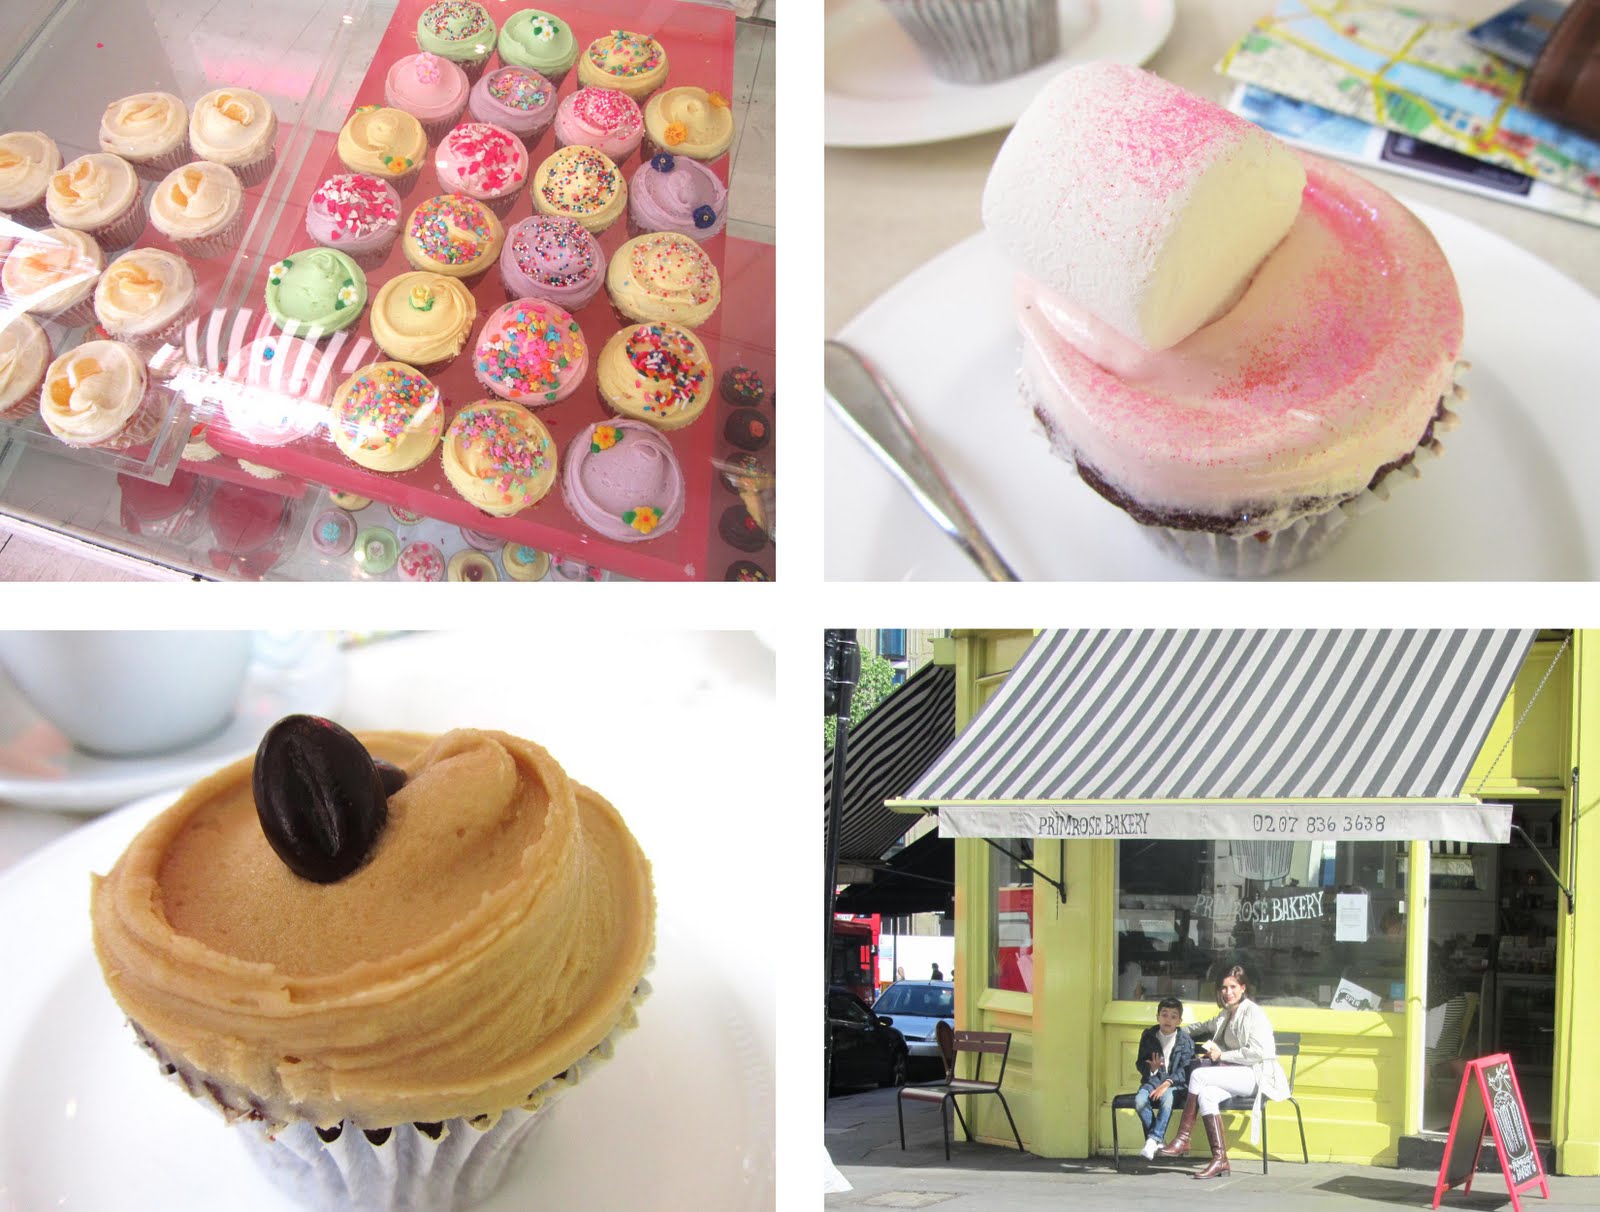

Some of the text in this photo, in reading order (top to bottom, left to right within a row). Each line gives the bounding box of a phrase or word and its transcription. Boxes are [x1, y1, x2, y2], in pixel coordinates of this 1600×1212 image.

[1038, 811, 1150, 837] PRIMROSE BAKERY
[1253, 814, 1386, 833] 0207 836 3638
[1191, 893, 1270, 923] PRROSE
[1271, 891, 1324, 922] BAKERY
